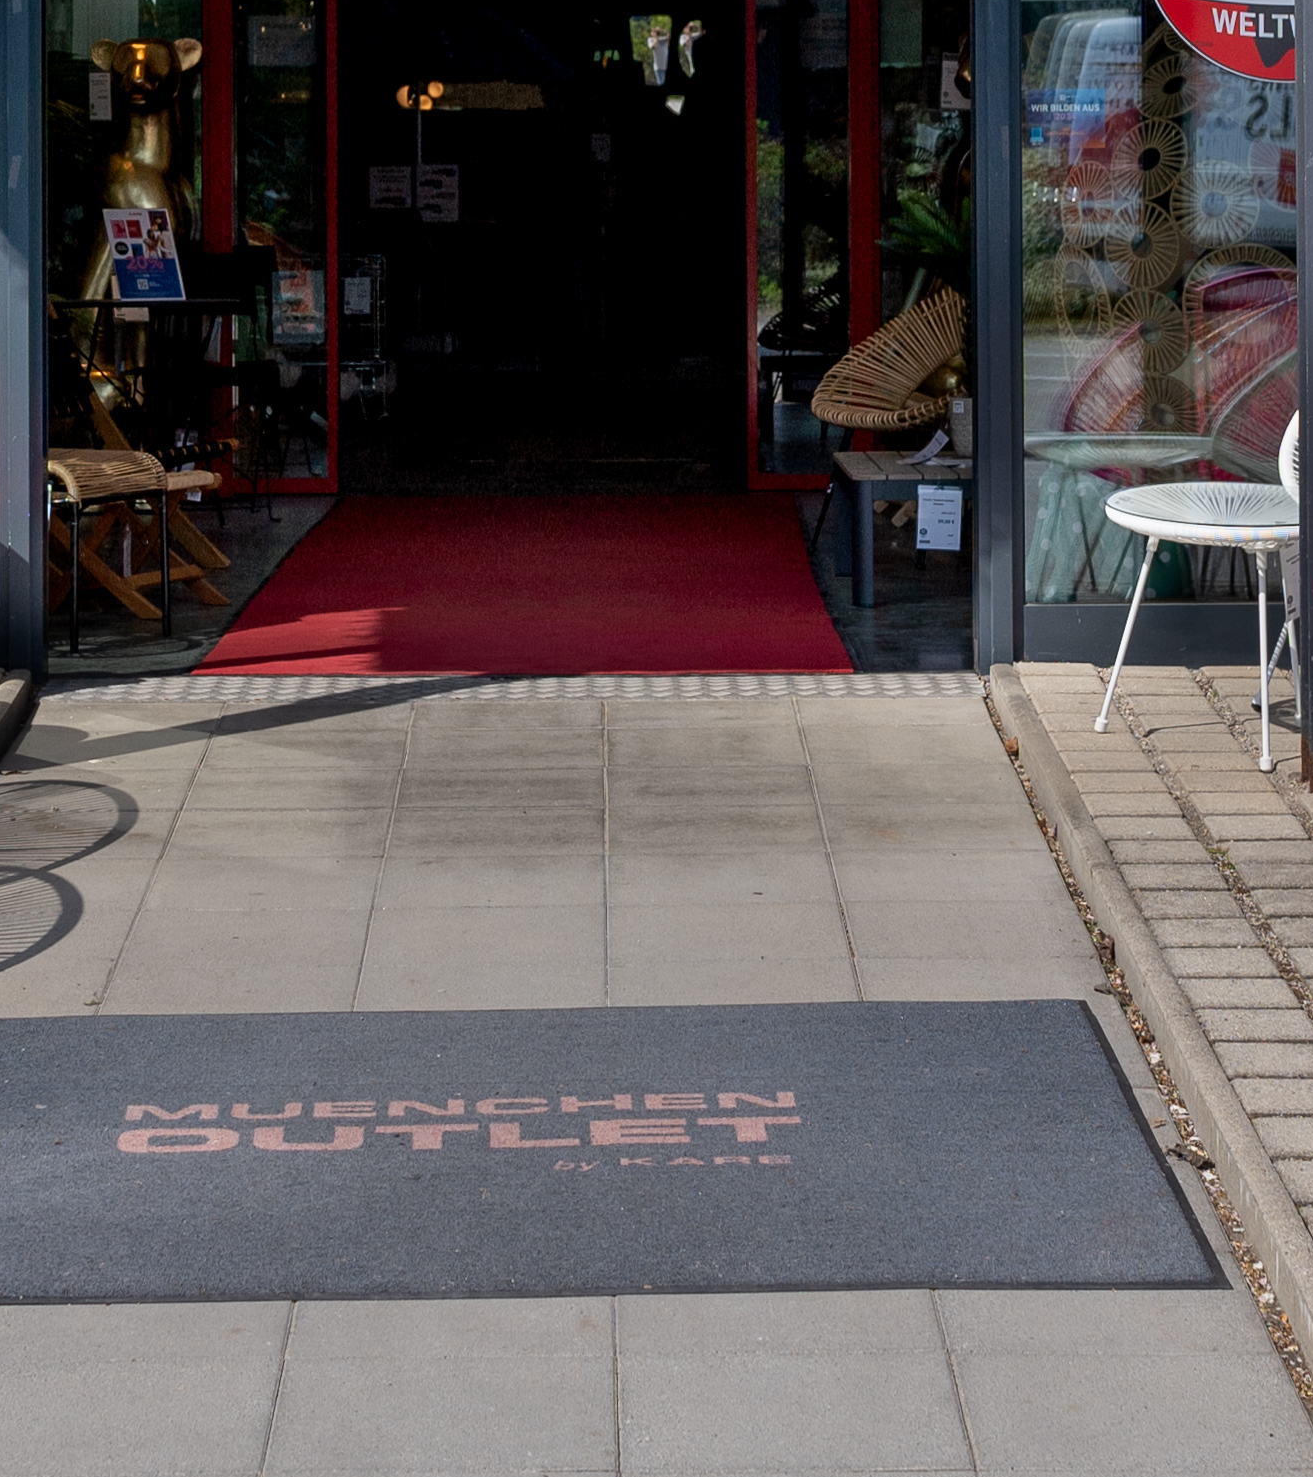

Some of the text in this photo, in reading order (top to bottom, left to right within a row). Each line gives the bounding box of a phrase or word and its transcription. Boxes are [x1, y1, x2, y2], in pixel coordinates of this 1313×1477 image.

[1031, 104, 1100, 112] WIR BILDEN AUS
[125, 256, 164, 270] 20%
[125, 1090, 797, 1122] MUENCHEN
[116, 1115, 802, 1155] OUTLET
[553, 1160, 600, 1172] by
